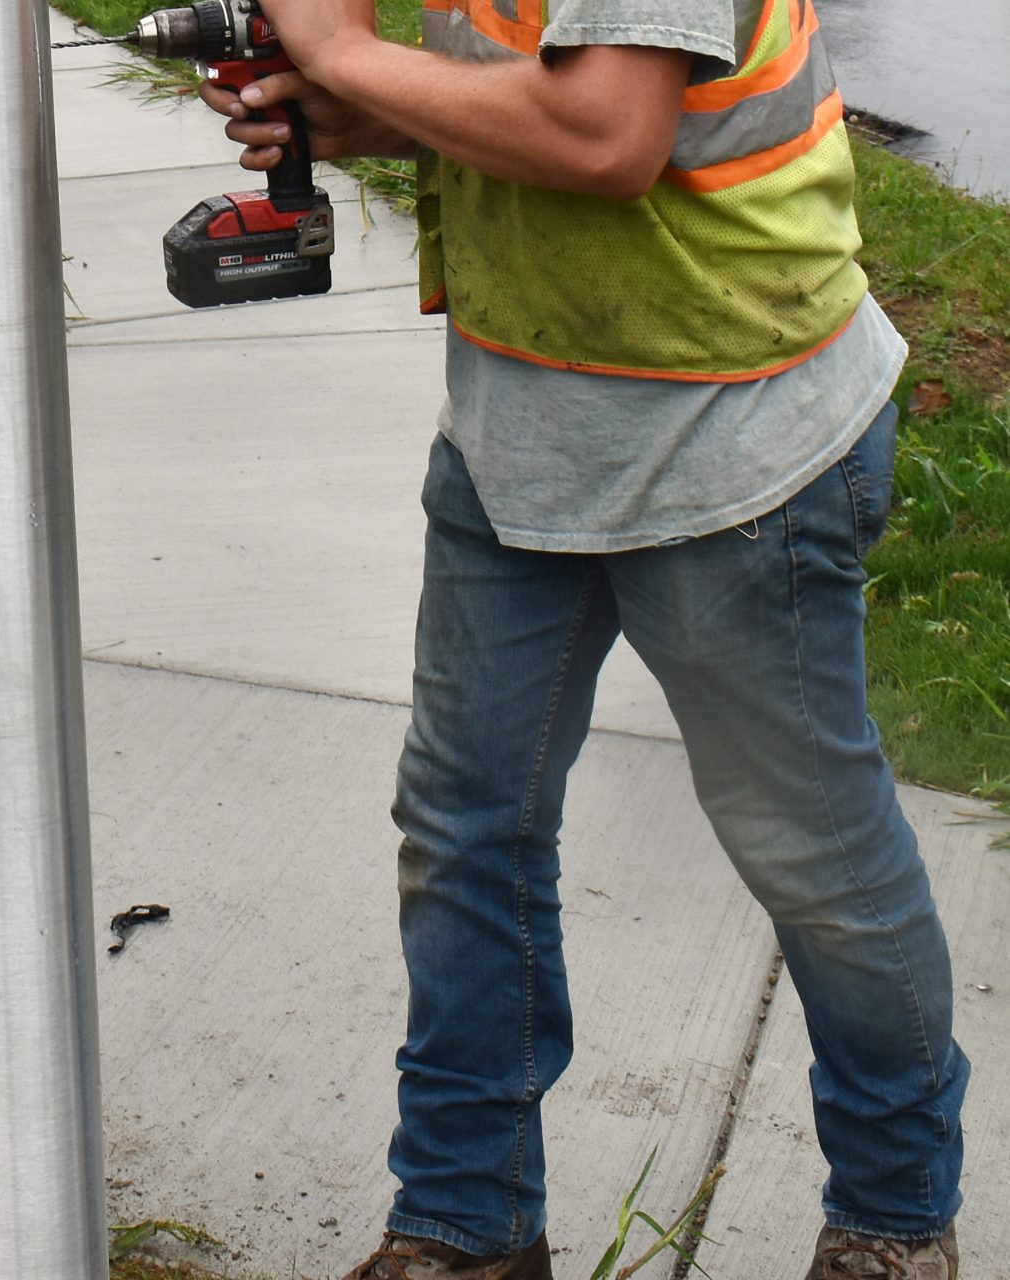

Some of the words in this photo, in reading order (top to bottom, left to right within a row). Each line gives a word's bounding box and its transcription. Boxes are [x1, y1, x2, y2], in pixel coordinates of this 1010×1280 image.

[243, 252, 298, 265] REDLITHIU
[219, 267, 242, 277] HIGH
[244, 264, 279, 274] OUTPUT
